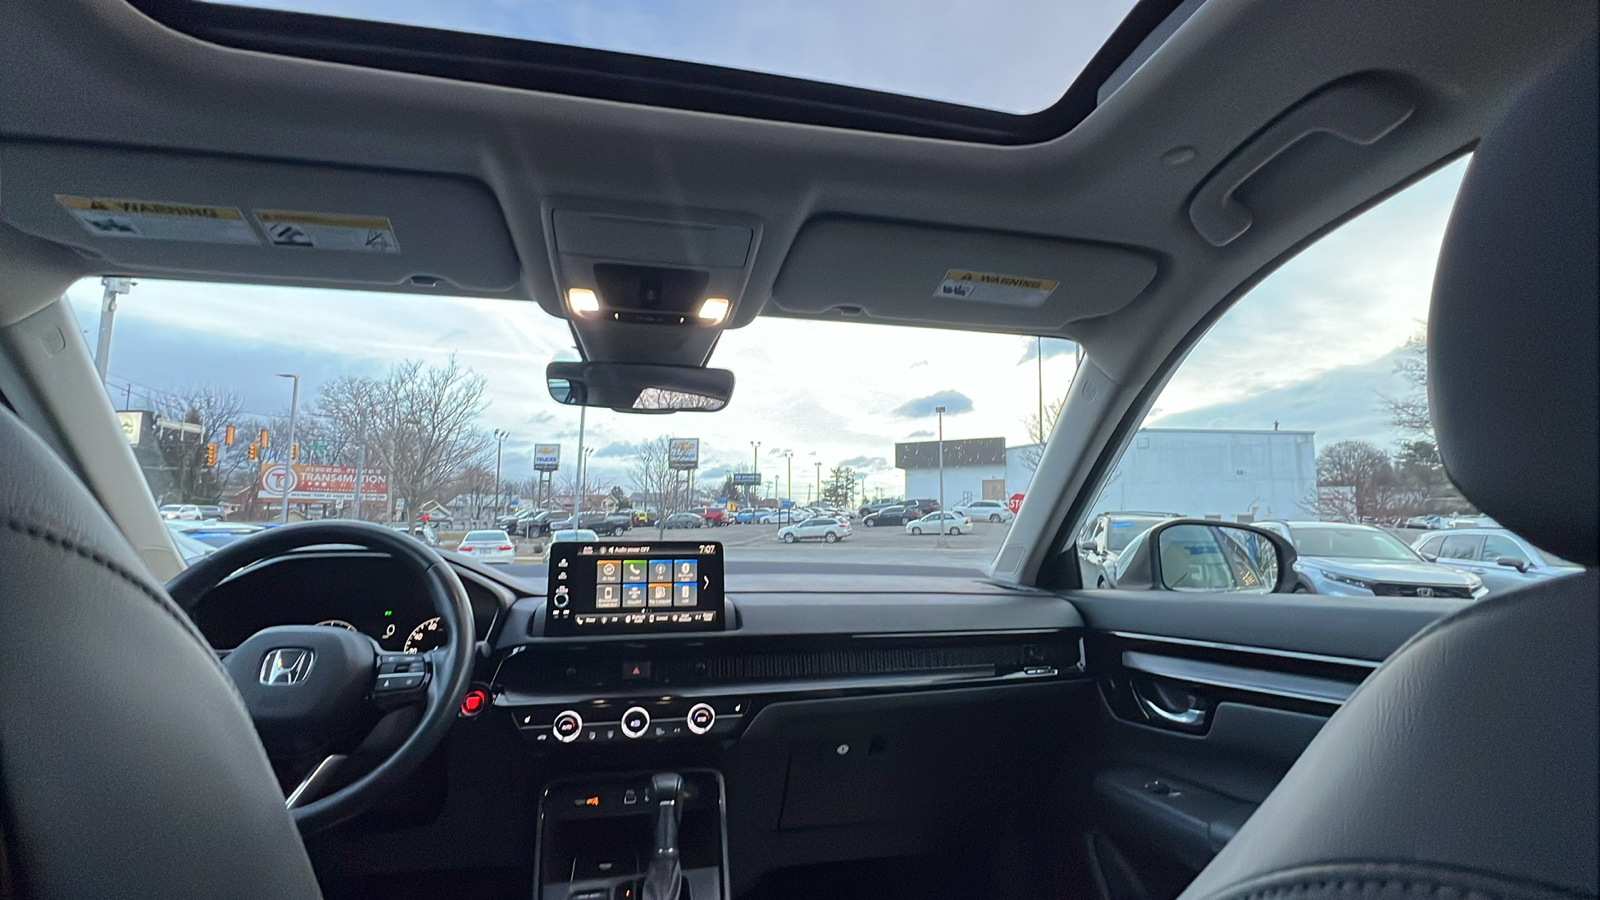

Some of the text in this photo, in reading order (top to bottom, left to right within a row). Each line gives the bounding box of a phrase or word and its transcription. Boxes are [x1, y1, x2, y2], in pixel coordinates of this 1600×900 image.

[980, 274, 1042, 288] WARNING
[698, 545, 715, 553] 7:07
[428, 622, 438, 631] 60
[414, 632, 424, 641] 40
